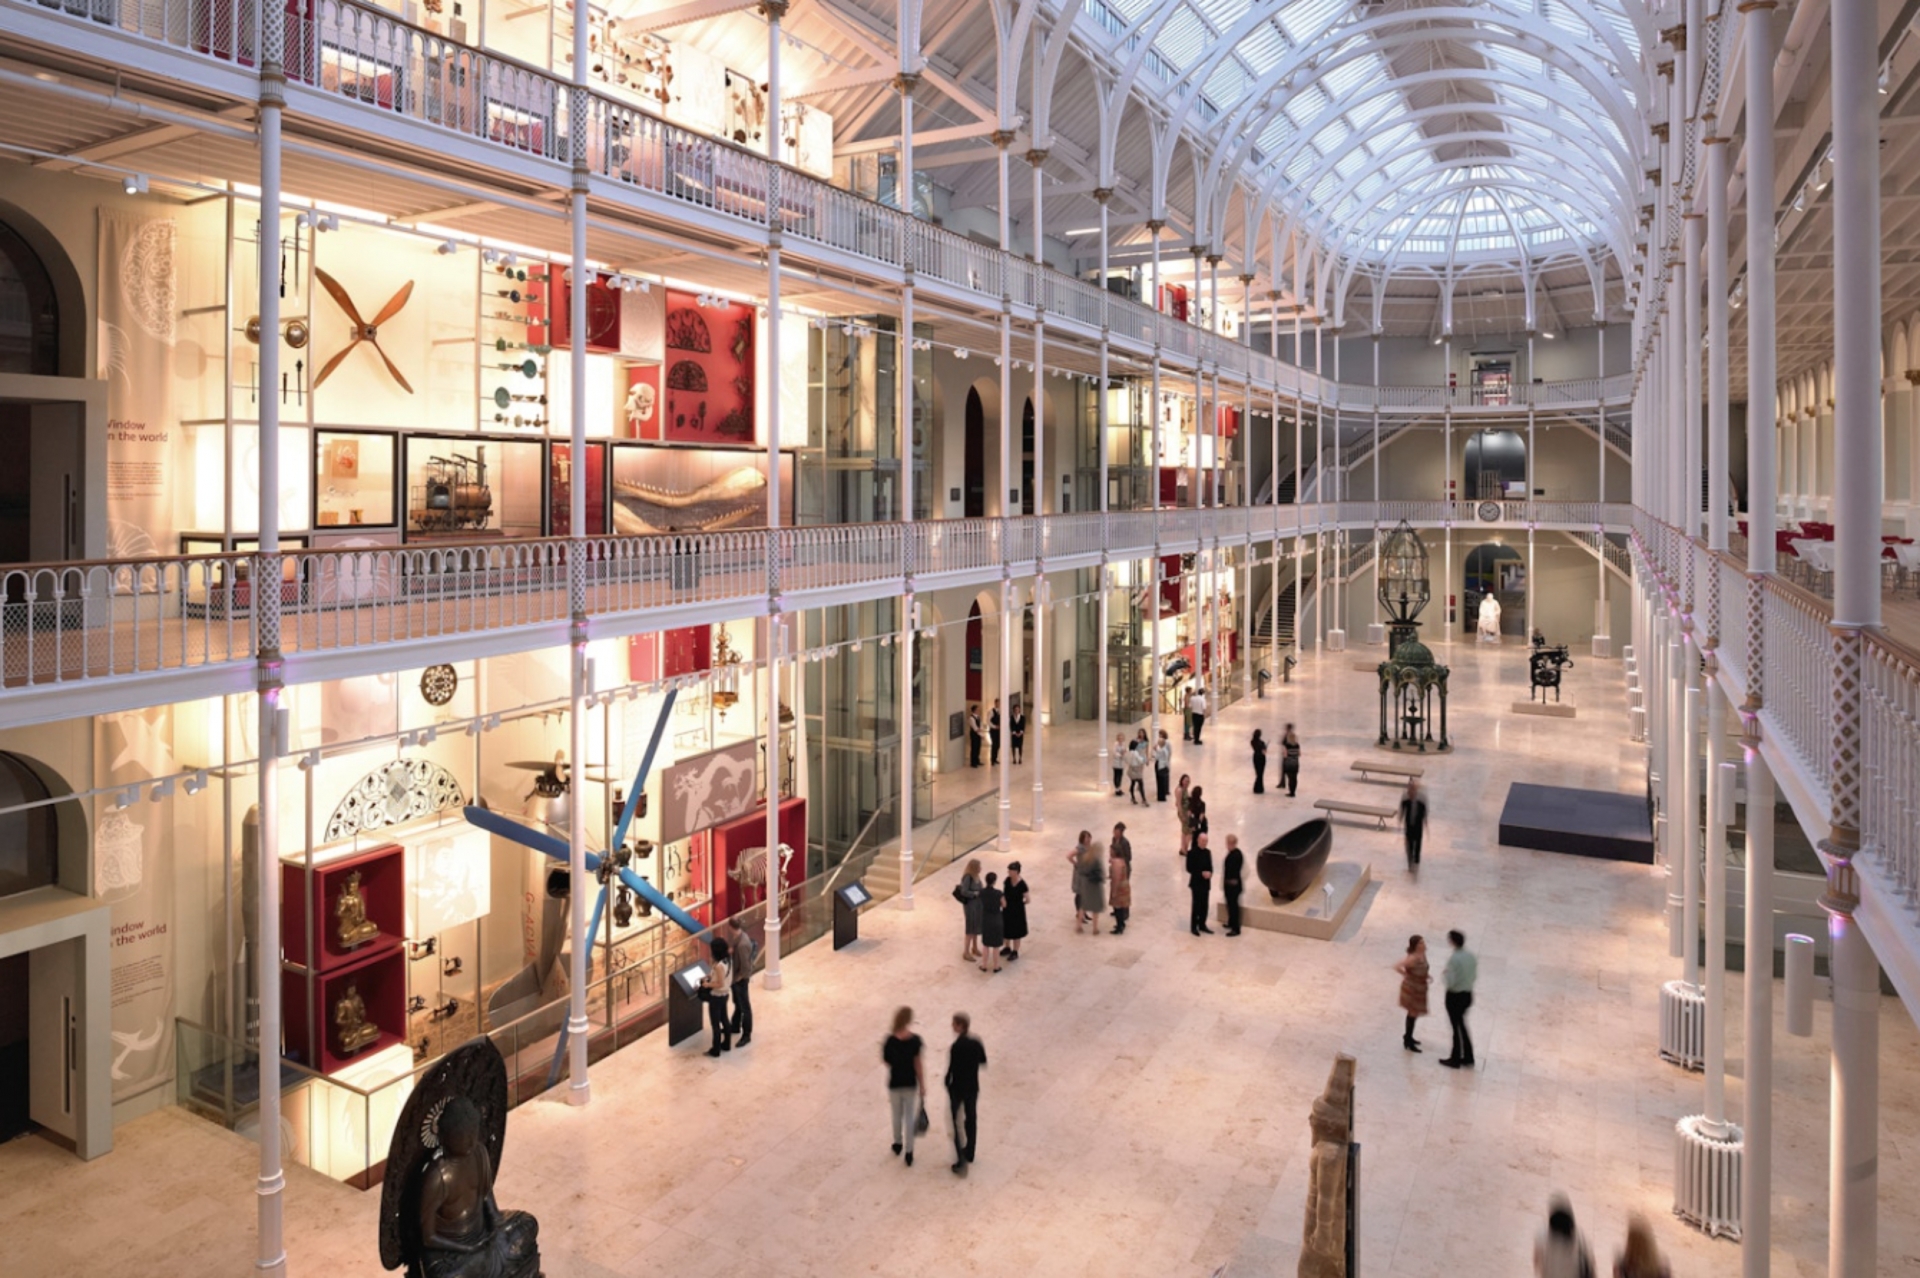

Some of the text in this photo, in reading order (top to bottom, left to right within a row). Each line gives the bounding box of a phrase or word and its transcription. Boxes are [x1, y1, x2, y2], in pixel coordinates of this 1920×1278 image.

[119, 431, 136, 441] the
[139, 432, 168, 442] world
[111, 921, 144, 936] indow
[116, 935, 135, 946] the
[138, 923, 167, 940] world
